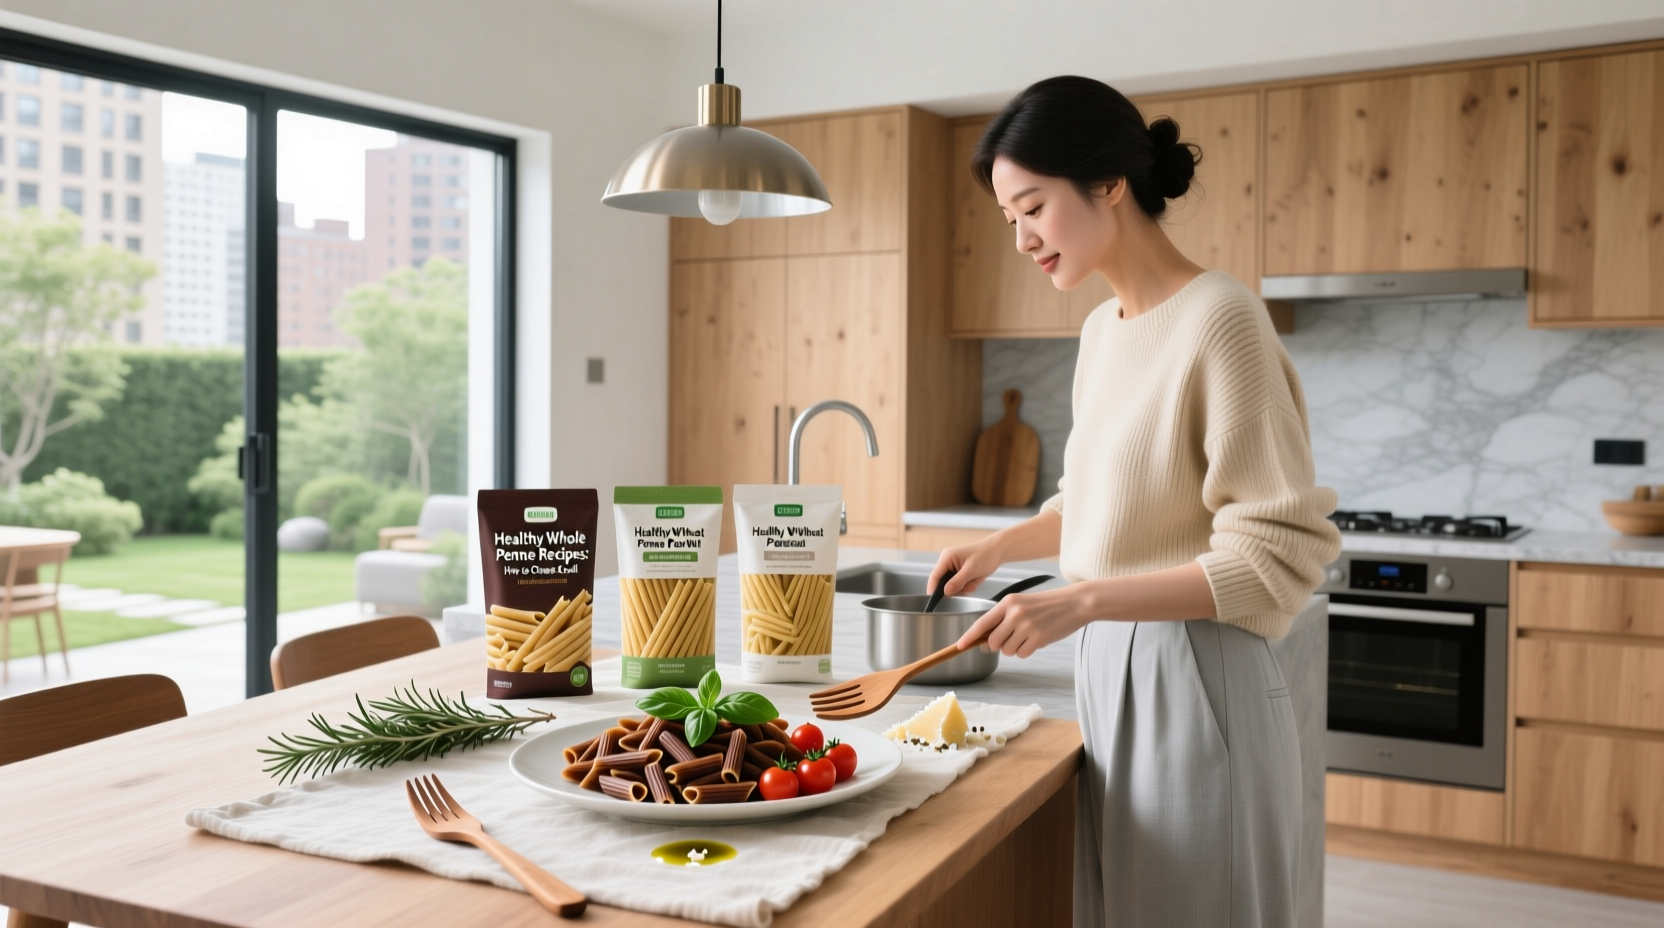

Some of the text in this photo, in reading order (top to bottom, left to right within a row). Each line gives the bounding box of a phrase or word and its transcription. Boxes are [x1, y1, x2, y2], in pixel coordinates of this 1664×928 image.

[494, 530, 586, 547] Healthy Whole
[496, 549, 536, 561] Penne
